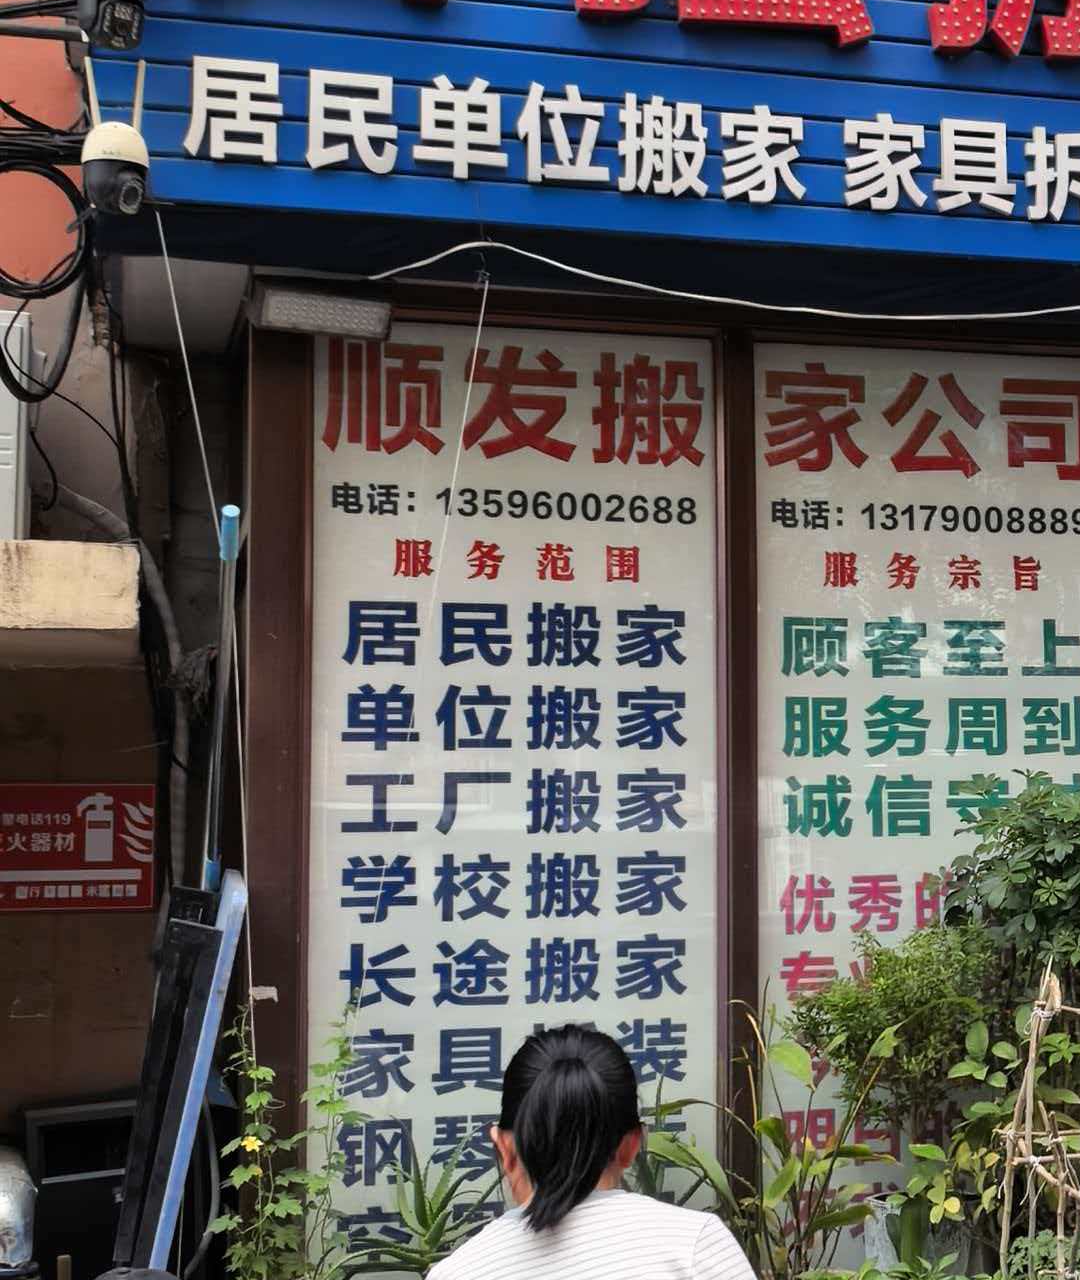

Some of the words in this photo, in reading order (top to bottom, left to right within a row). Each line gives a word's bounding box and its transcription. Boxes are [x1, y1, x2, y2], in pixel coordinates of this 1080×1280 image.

[183, 54, 807, 205] 居民单位搬家
[394, 538, 641, 583] 服务范围
[823, 551, 1042, 592] 服务宗旨
[341, 600, 687, 669] 居民搬家
[341, 684, 687, 751] 单位搬家
[340, 768, 687, 836] 工厂搬家
[340, 850, 687, 923] 学校搬家
[339, 933, 687, 1009] 长途搬家
[338, 1017, 687, 1098] 家具装
